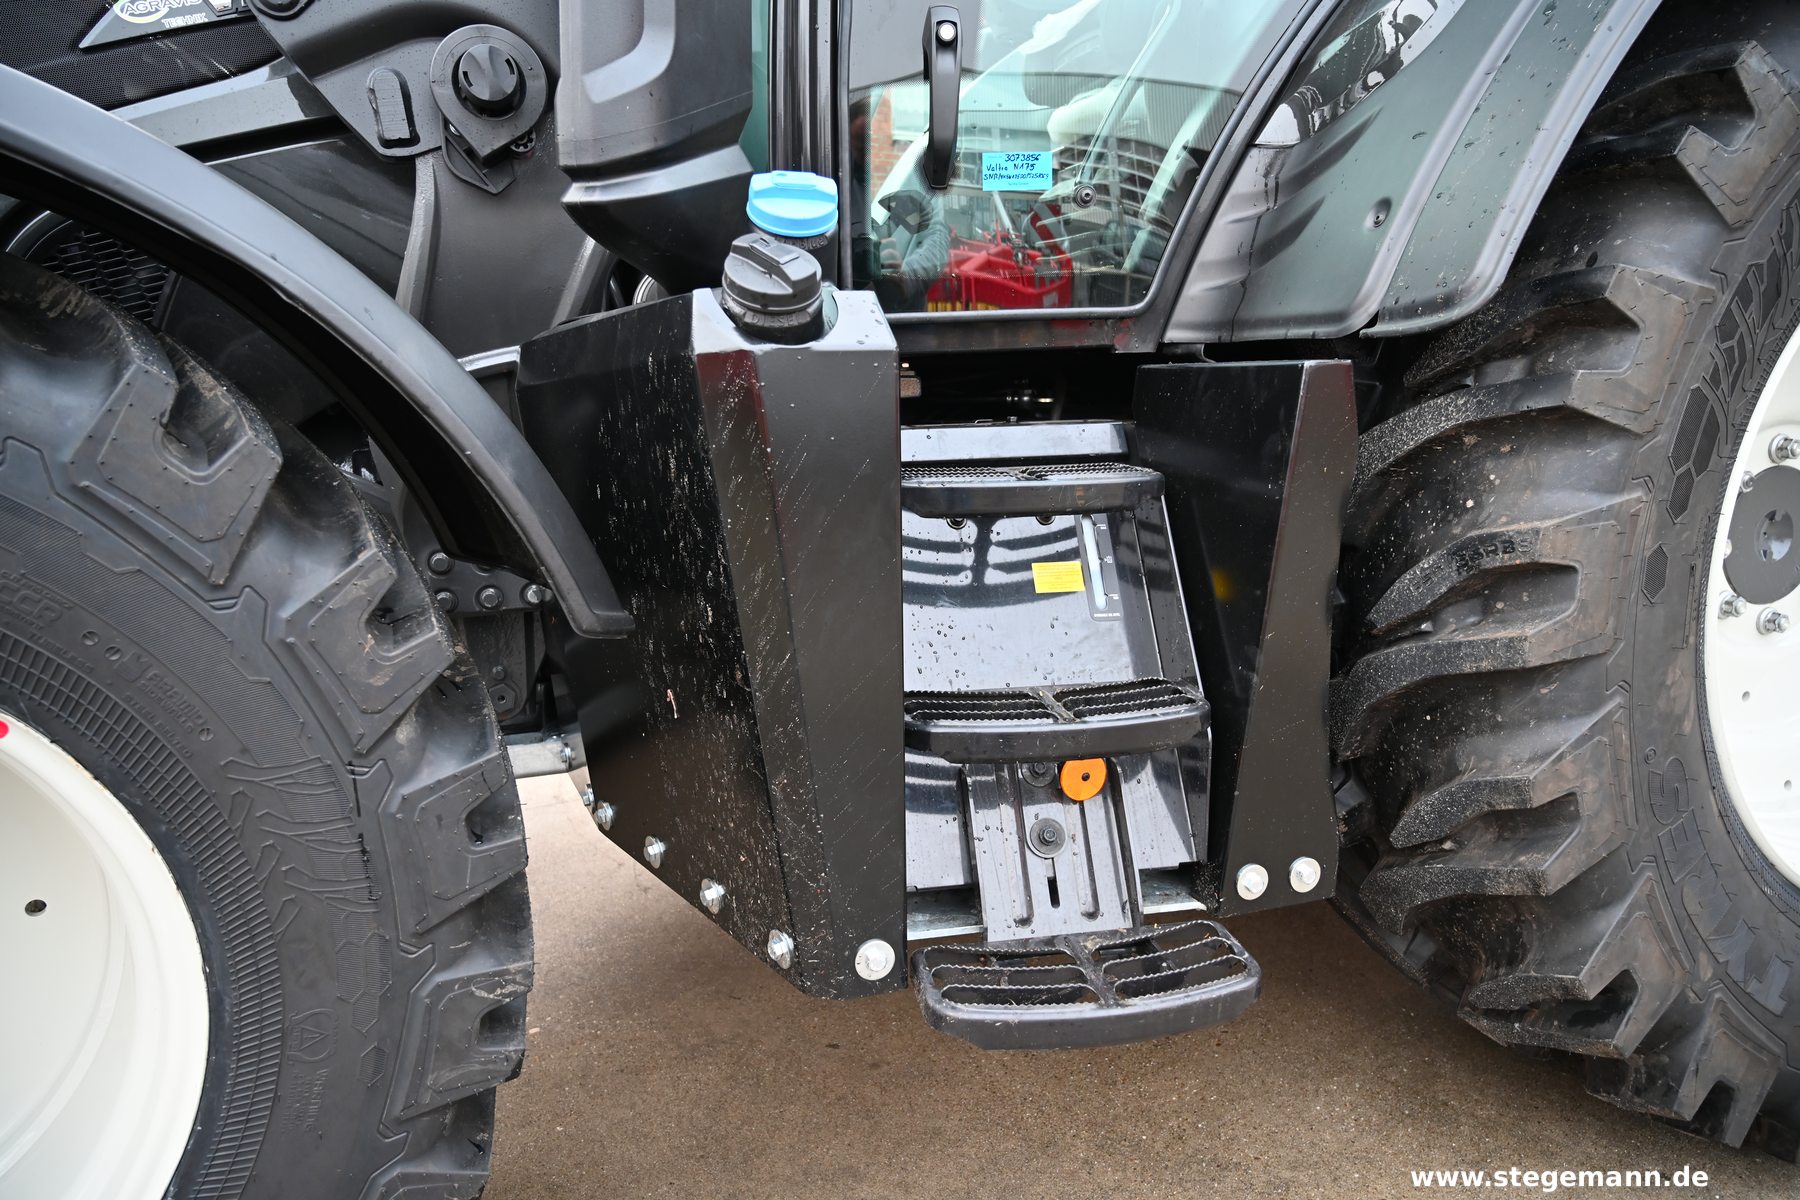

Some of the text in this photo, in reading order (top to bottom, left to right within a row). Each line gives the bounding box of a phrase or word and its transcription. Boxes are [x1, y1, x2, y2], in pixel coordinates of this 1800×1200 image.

[161, 12, 209, 29] TECHNIK
[1004, 153, 1041, 162] 3073856
[1013, 162, 1036, 171] N175
[1648, 756, 1789, 1015] TYRES
